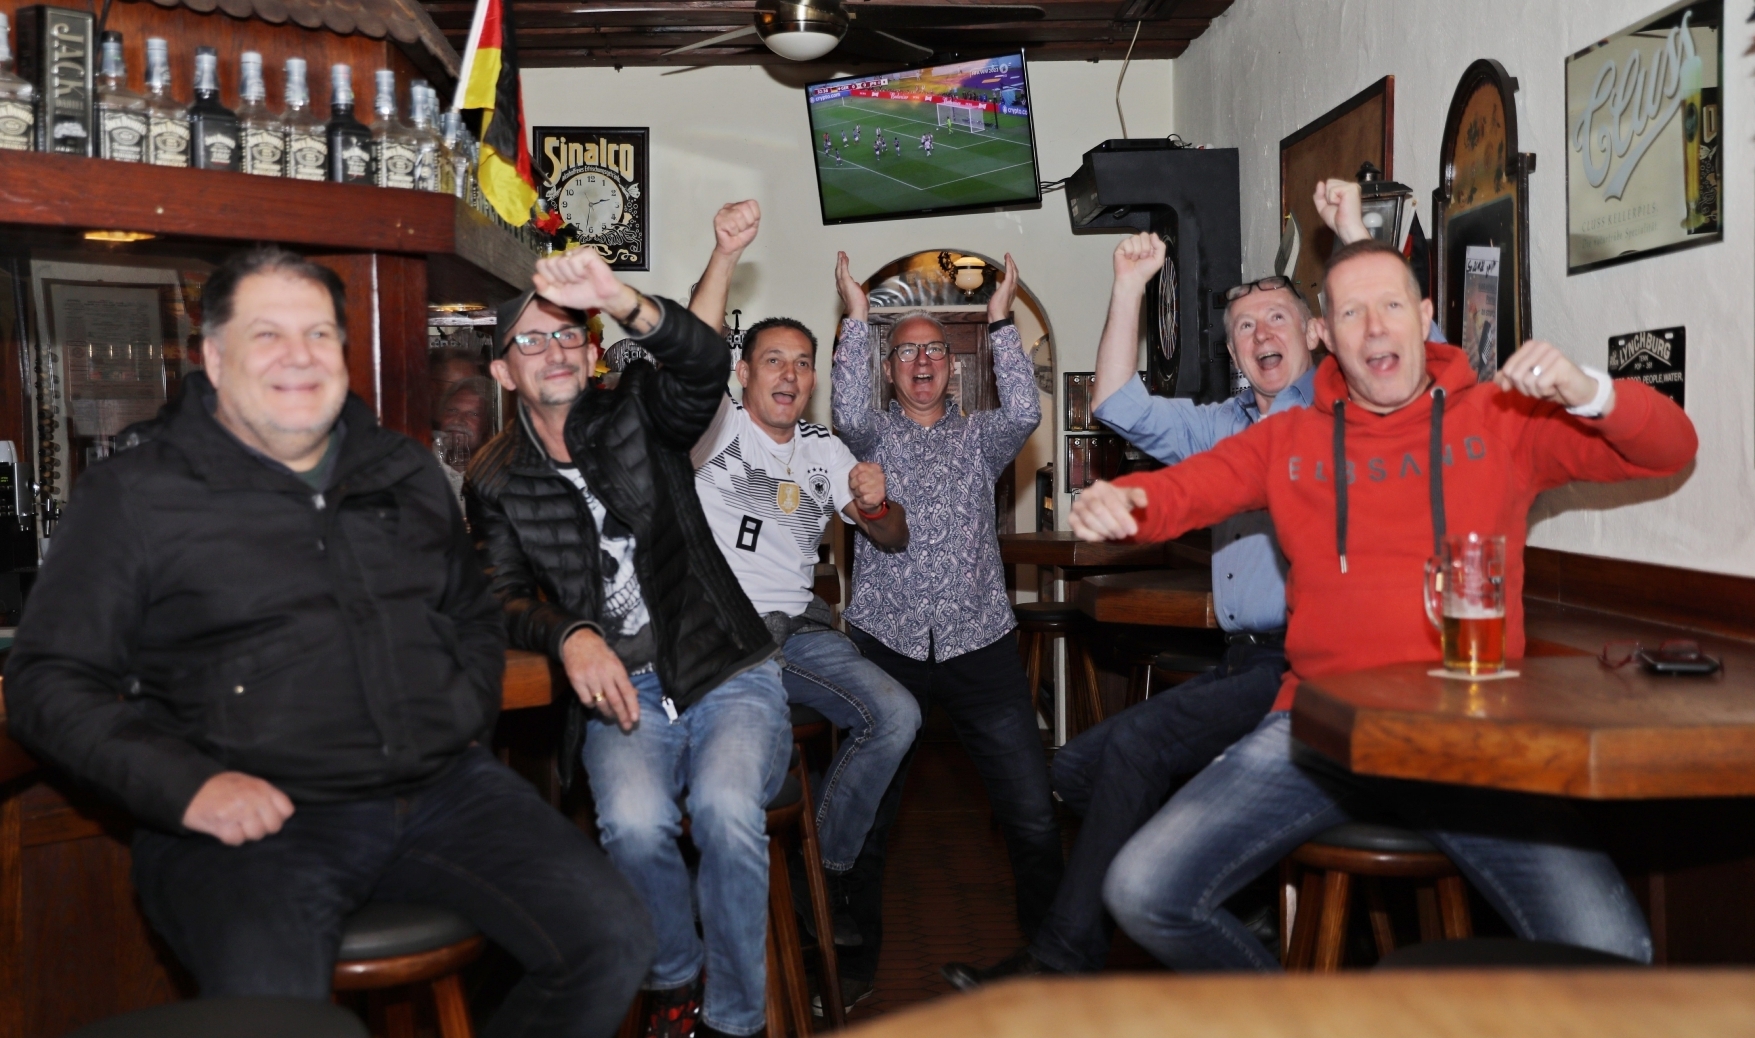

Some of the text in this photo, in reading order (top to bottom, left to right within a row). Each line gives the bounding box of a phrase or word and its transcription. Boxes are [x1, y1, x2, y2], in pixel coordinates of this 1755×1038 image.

[52, 23, 84, 98] JACK
[815, 92, 841, 102] crypto.com
[543, 136, 634, 187] Sinalco
[575, 179, 582, 187] 11
[587, 175, 596, 183] 12
[1581, 217, 1605, 233] CLUSS
[1619, 332, 1671, 364] LYNCHBURG
[735, 514, 764, 553] 8
